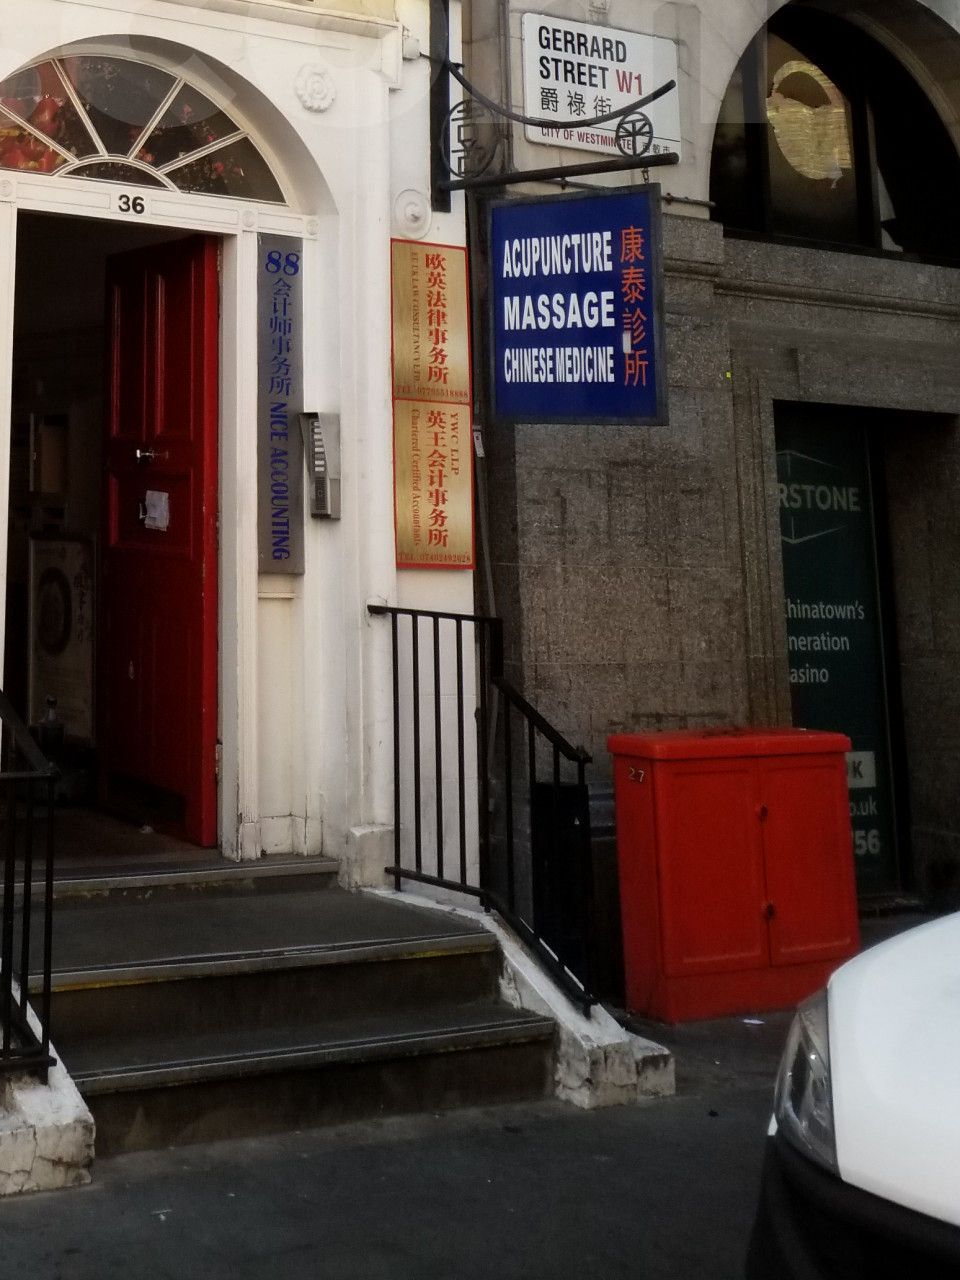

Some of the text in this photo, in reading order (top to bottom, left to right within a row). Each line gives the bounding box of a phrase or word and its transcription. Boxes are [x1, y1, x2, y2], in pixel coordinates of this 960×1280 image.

[538, 24, 628, 64] GERRARD
[539, 55, 644, 96] STREET W1
[541, 126, 636, 151] CITY OF WESTMINTE
[117, 194, 145, 215] 36
[502, 231, 614, 279] ACUPUNCTURE
[503, 290, 616, 332] MASSAGE
[503, 346, 616, 384] CHINESE MEDICINE
[450, 412, 459, 445] YWC
[269, 401, 291, 562] NICE ACCOUNTING
